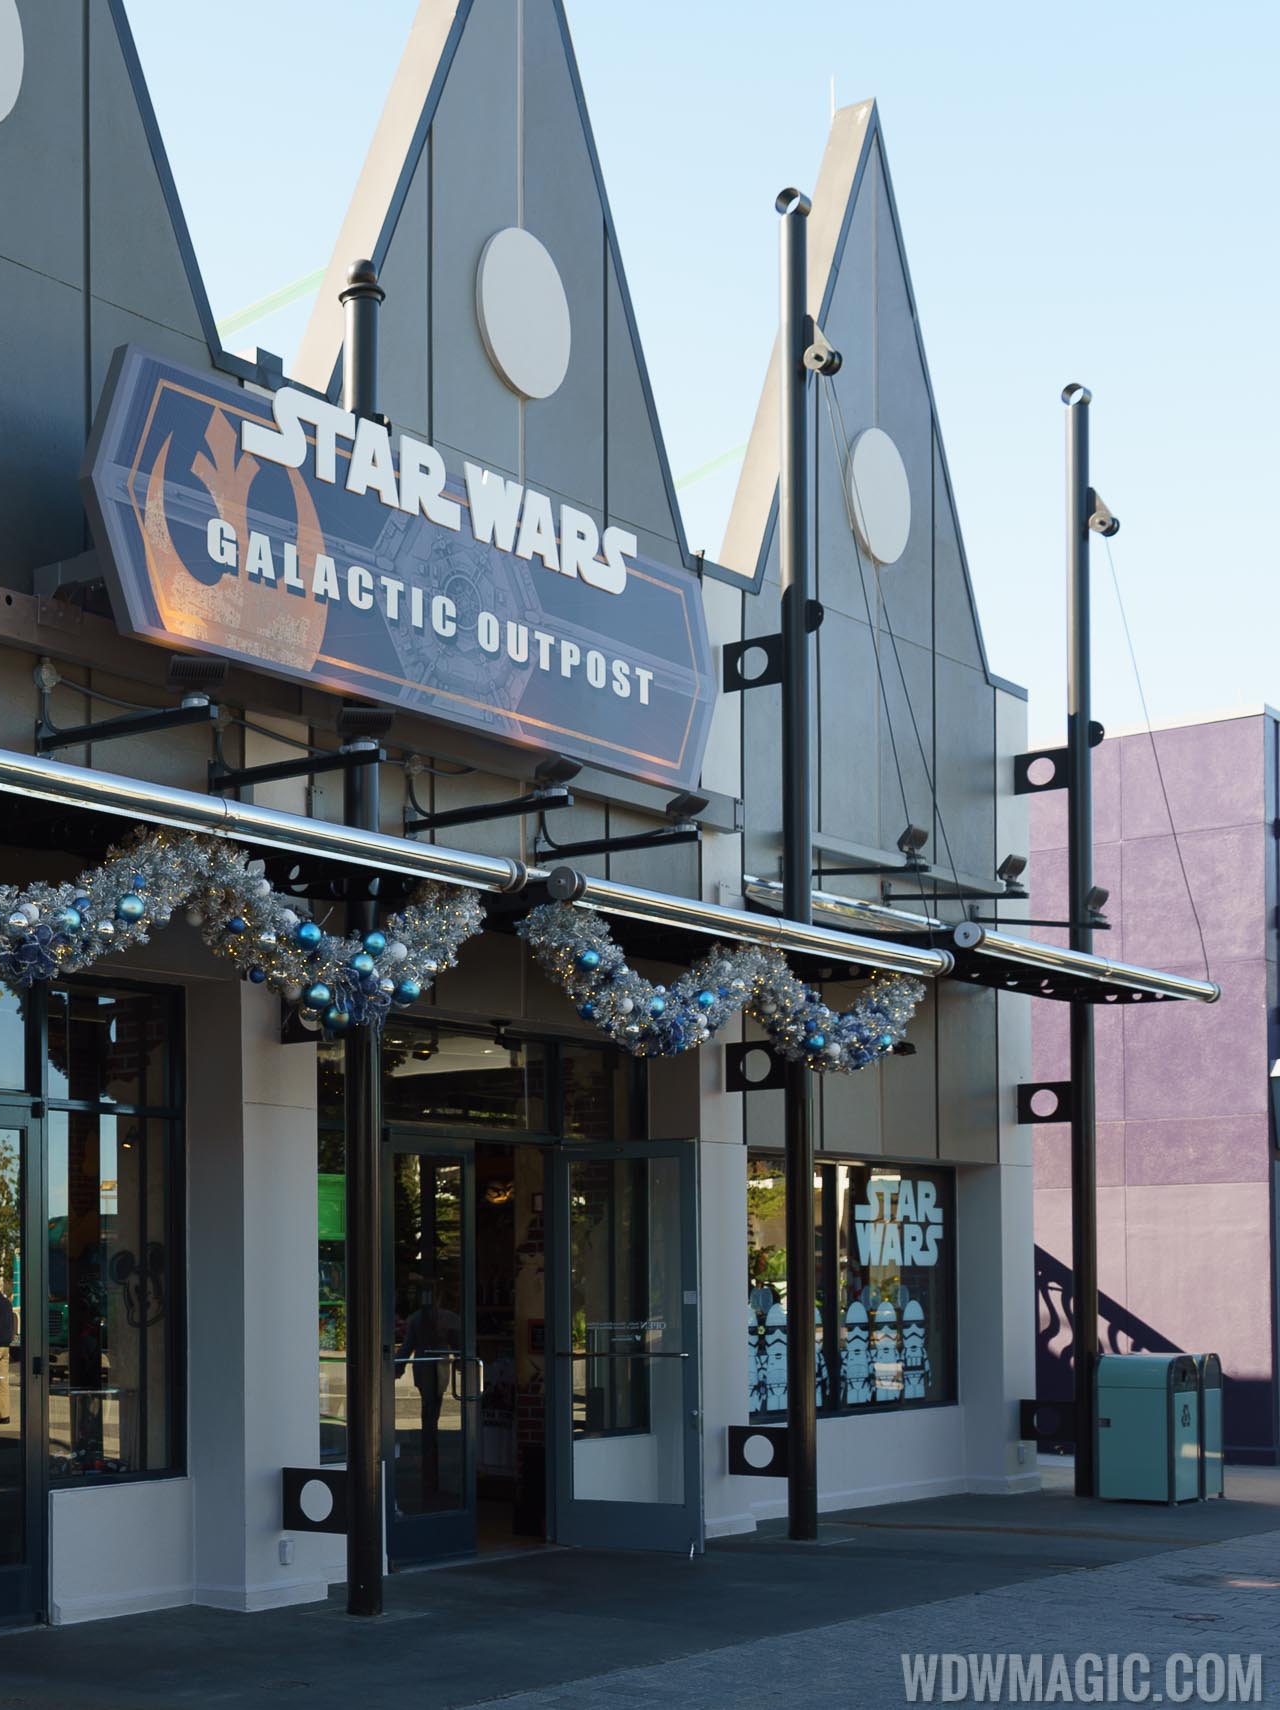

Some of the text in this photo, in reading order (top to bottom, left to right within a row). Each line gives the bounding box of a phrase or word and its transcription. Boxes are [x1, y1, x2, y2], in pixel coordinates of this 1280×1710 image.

[241, 386, 637, 595] STAR WARS
[207, 518, 654, 706] GALACTIC OUTPOST
[854, 1179, 943, 1223] STAR
[854, 1222, 943, 1266] WARS
